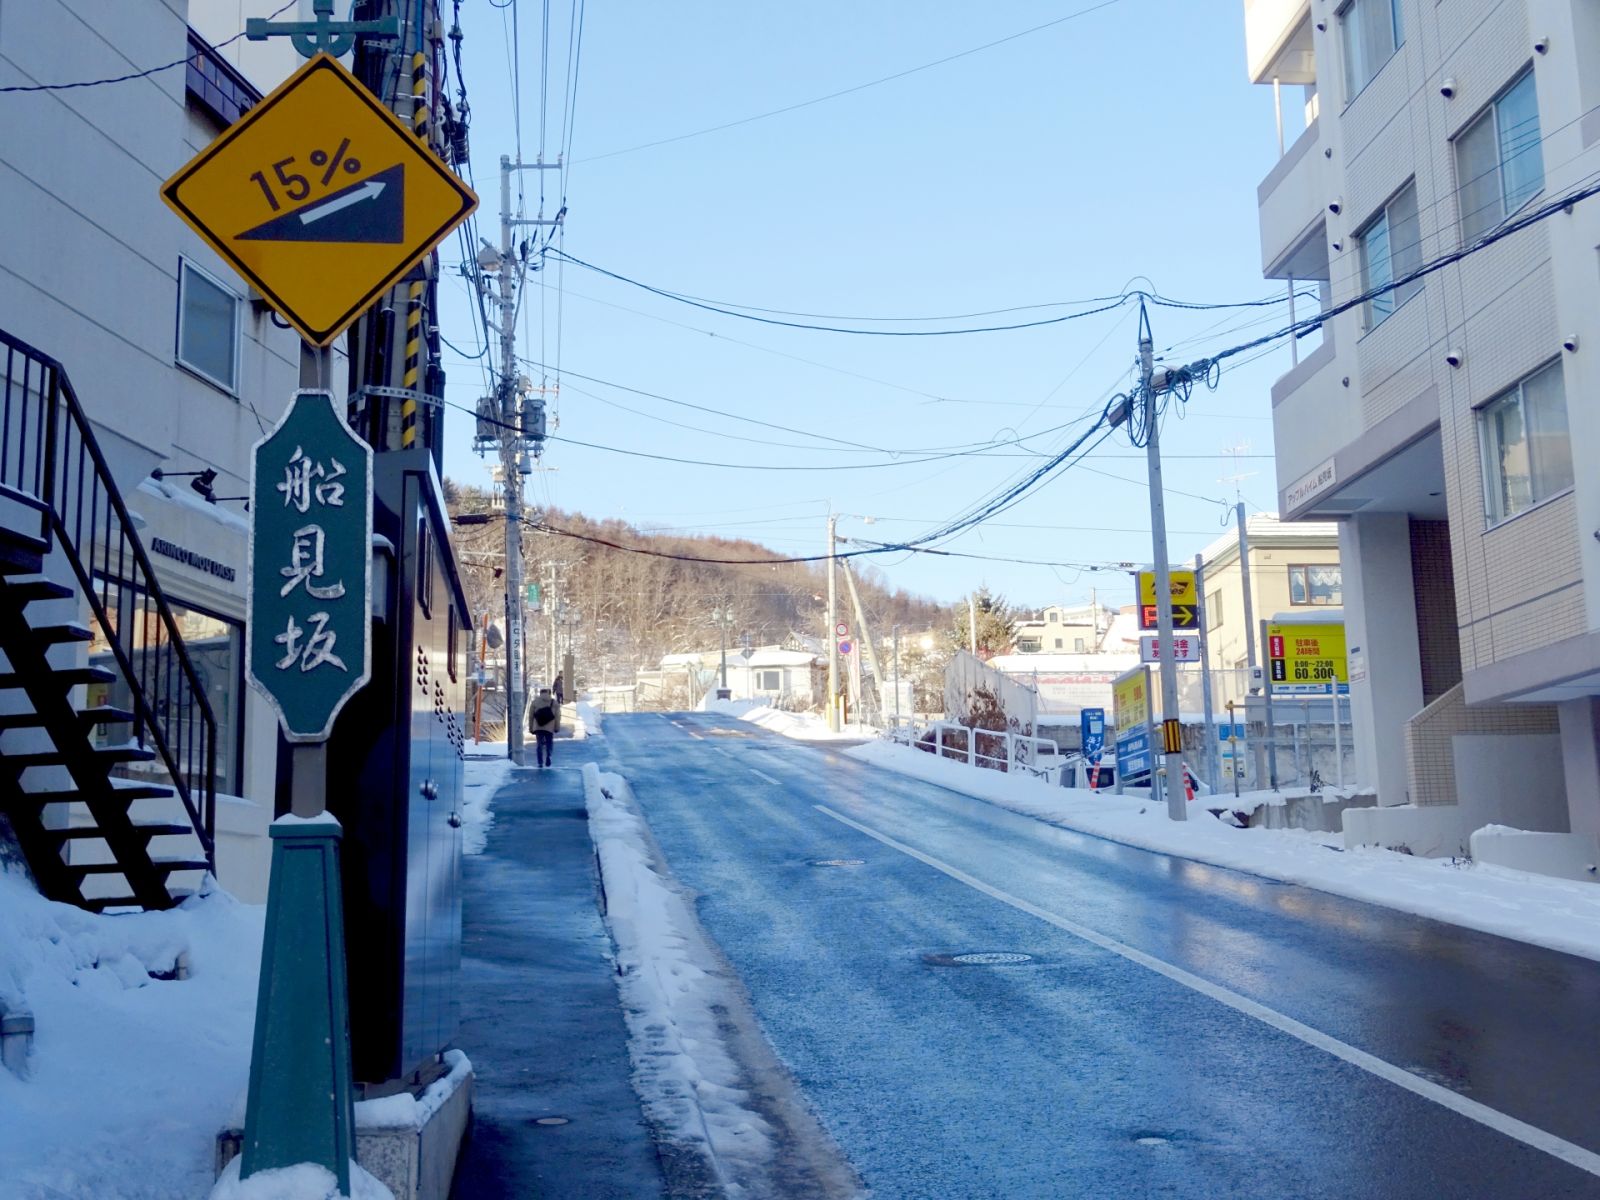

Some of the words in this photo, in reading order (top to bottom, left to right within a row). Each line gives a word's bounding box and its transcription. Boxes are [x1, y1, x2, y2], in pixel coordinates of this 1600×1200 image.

[249, 137, 361, 212] 15%
[211, 560, 236, 582] DASH
[275, 445, 348, 673] 船見坂
[1296, 647, 1320, 655] 24時間
